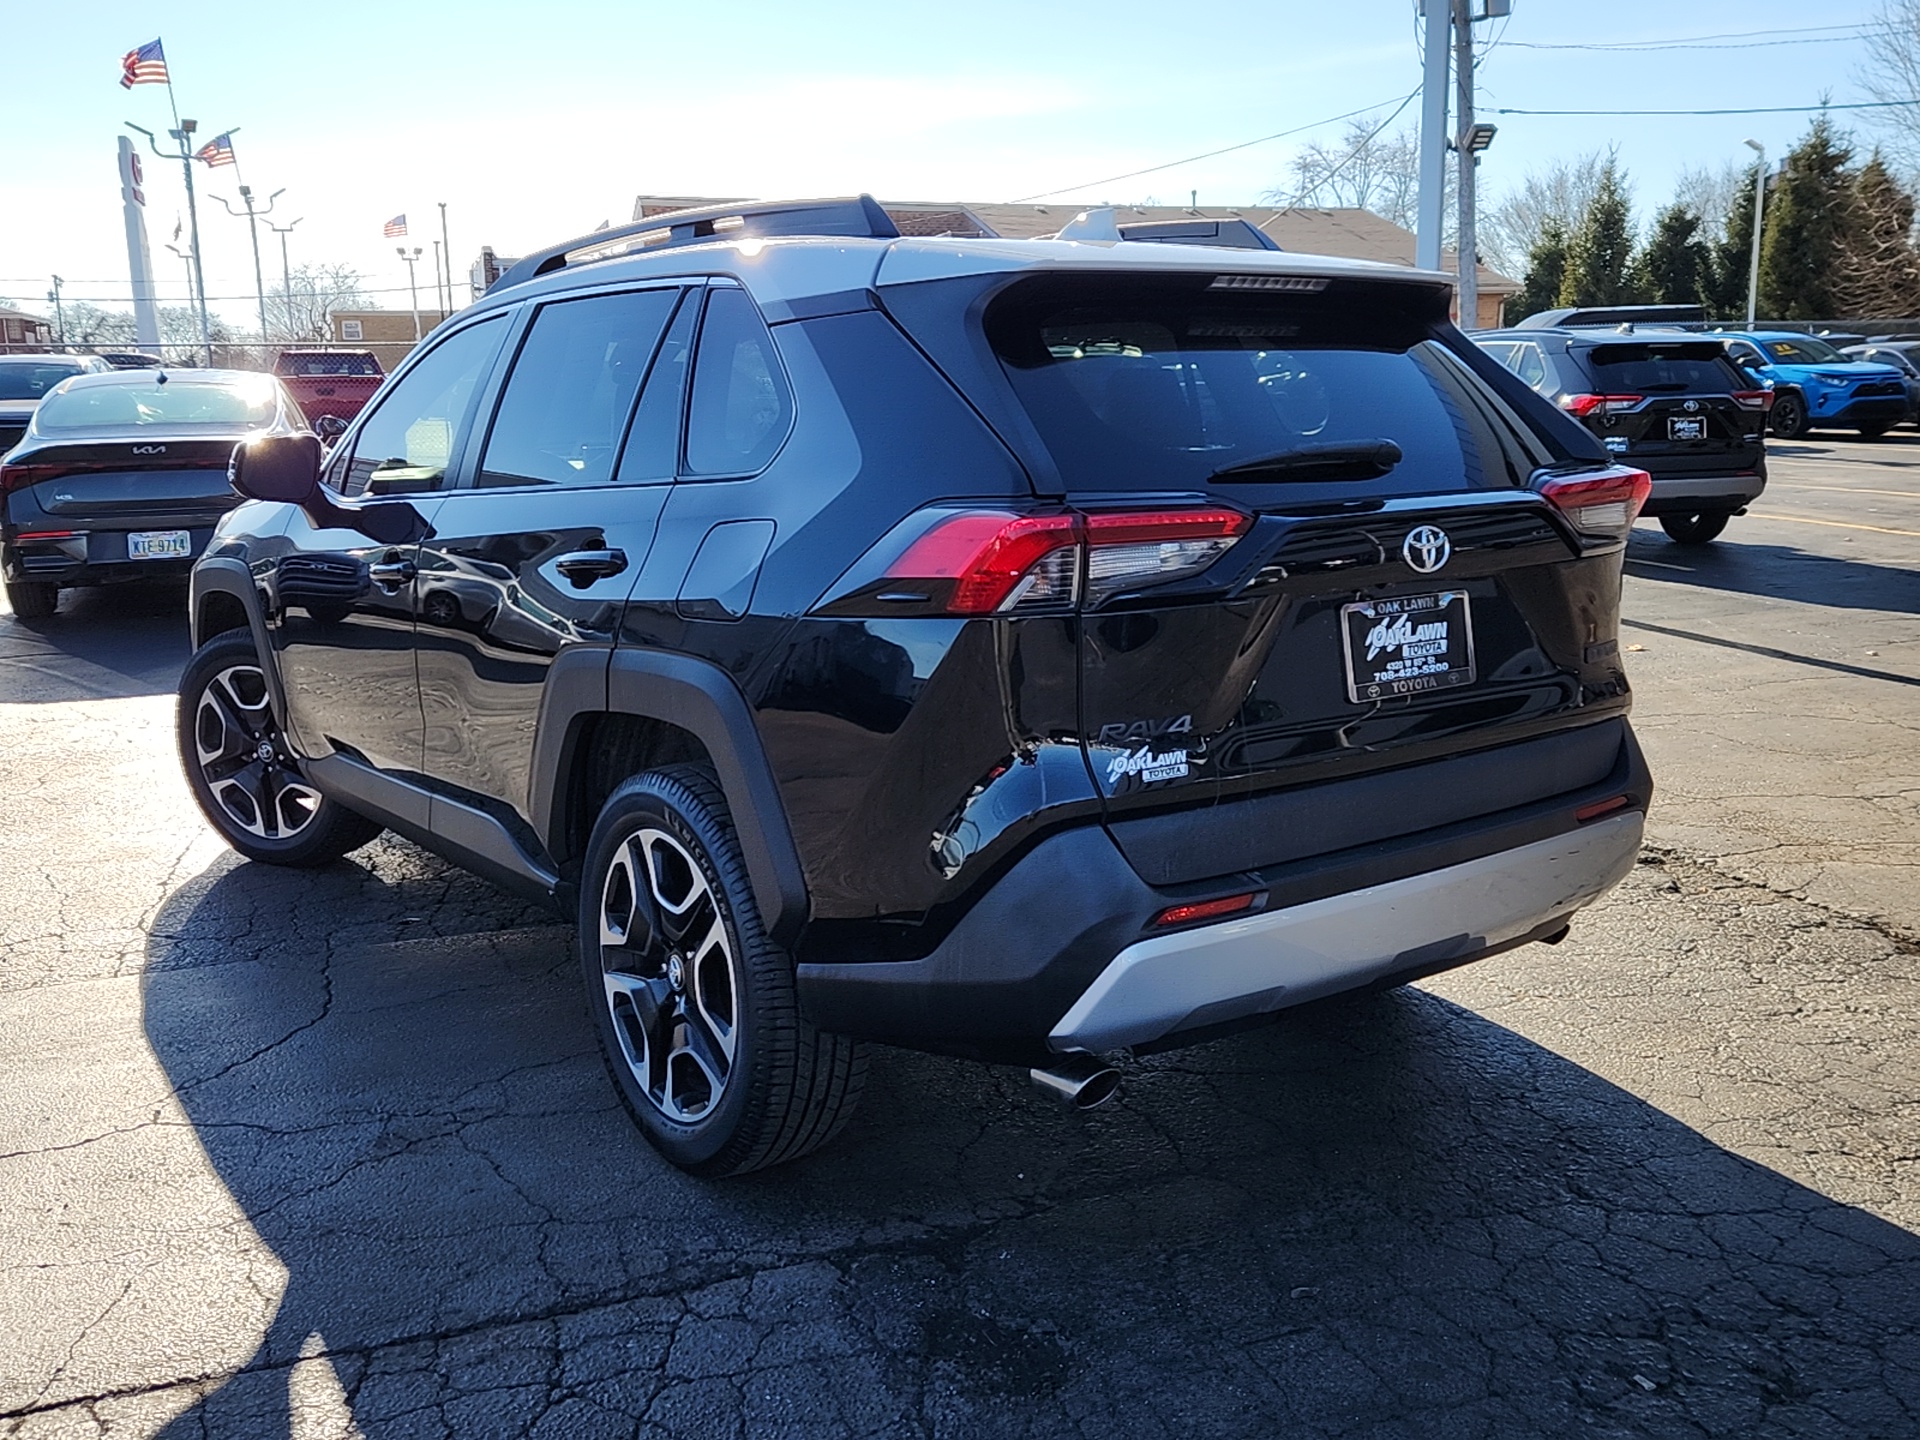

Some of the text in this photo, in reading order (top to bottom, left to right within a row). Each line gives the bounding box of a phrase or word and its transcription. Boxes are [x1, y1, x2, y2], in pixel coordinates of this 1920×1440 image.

[1377, 597, 1435, 613] OAK LAWN
[1408, 642, 1442, 656] TOYOTA
[1373, 662, 1449, 682] 708-423-5200
[1392, 676, 1437, 693] TOYOTA
[1099, 714, 1193, 742] RAV4
[1148, 767, 1182, 778] TOYOTA
[681, 827, 728, 916] MICHELIN
